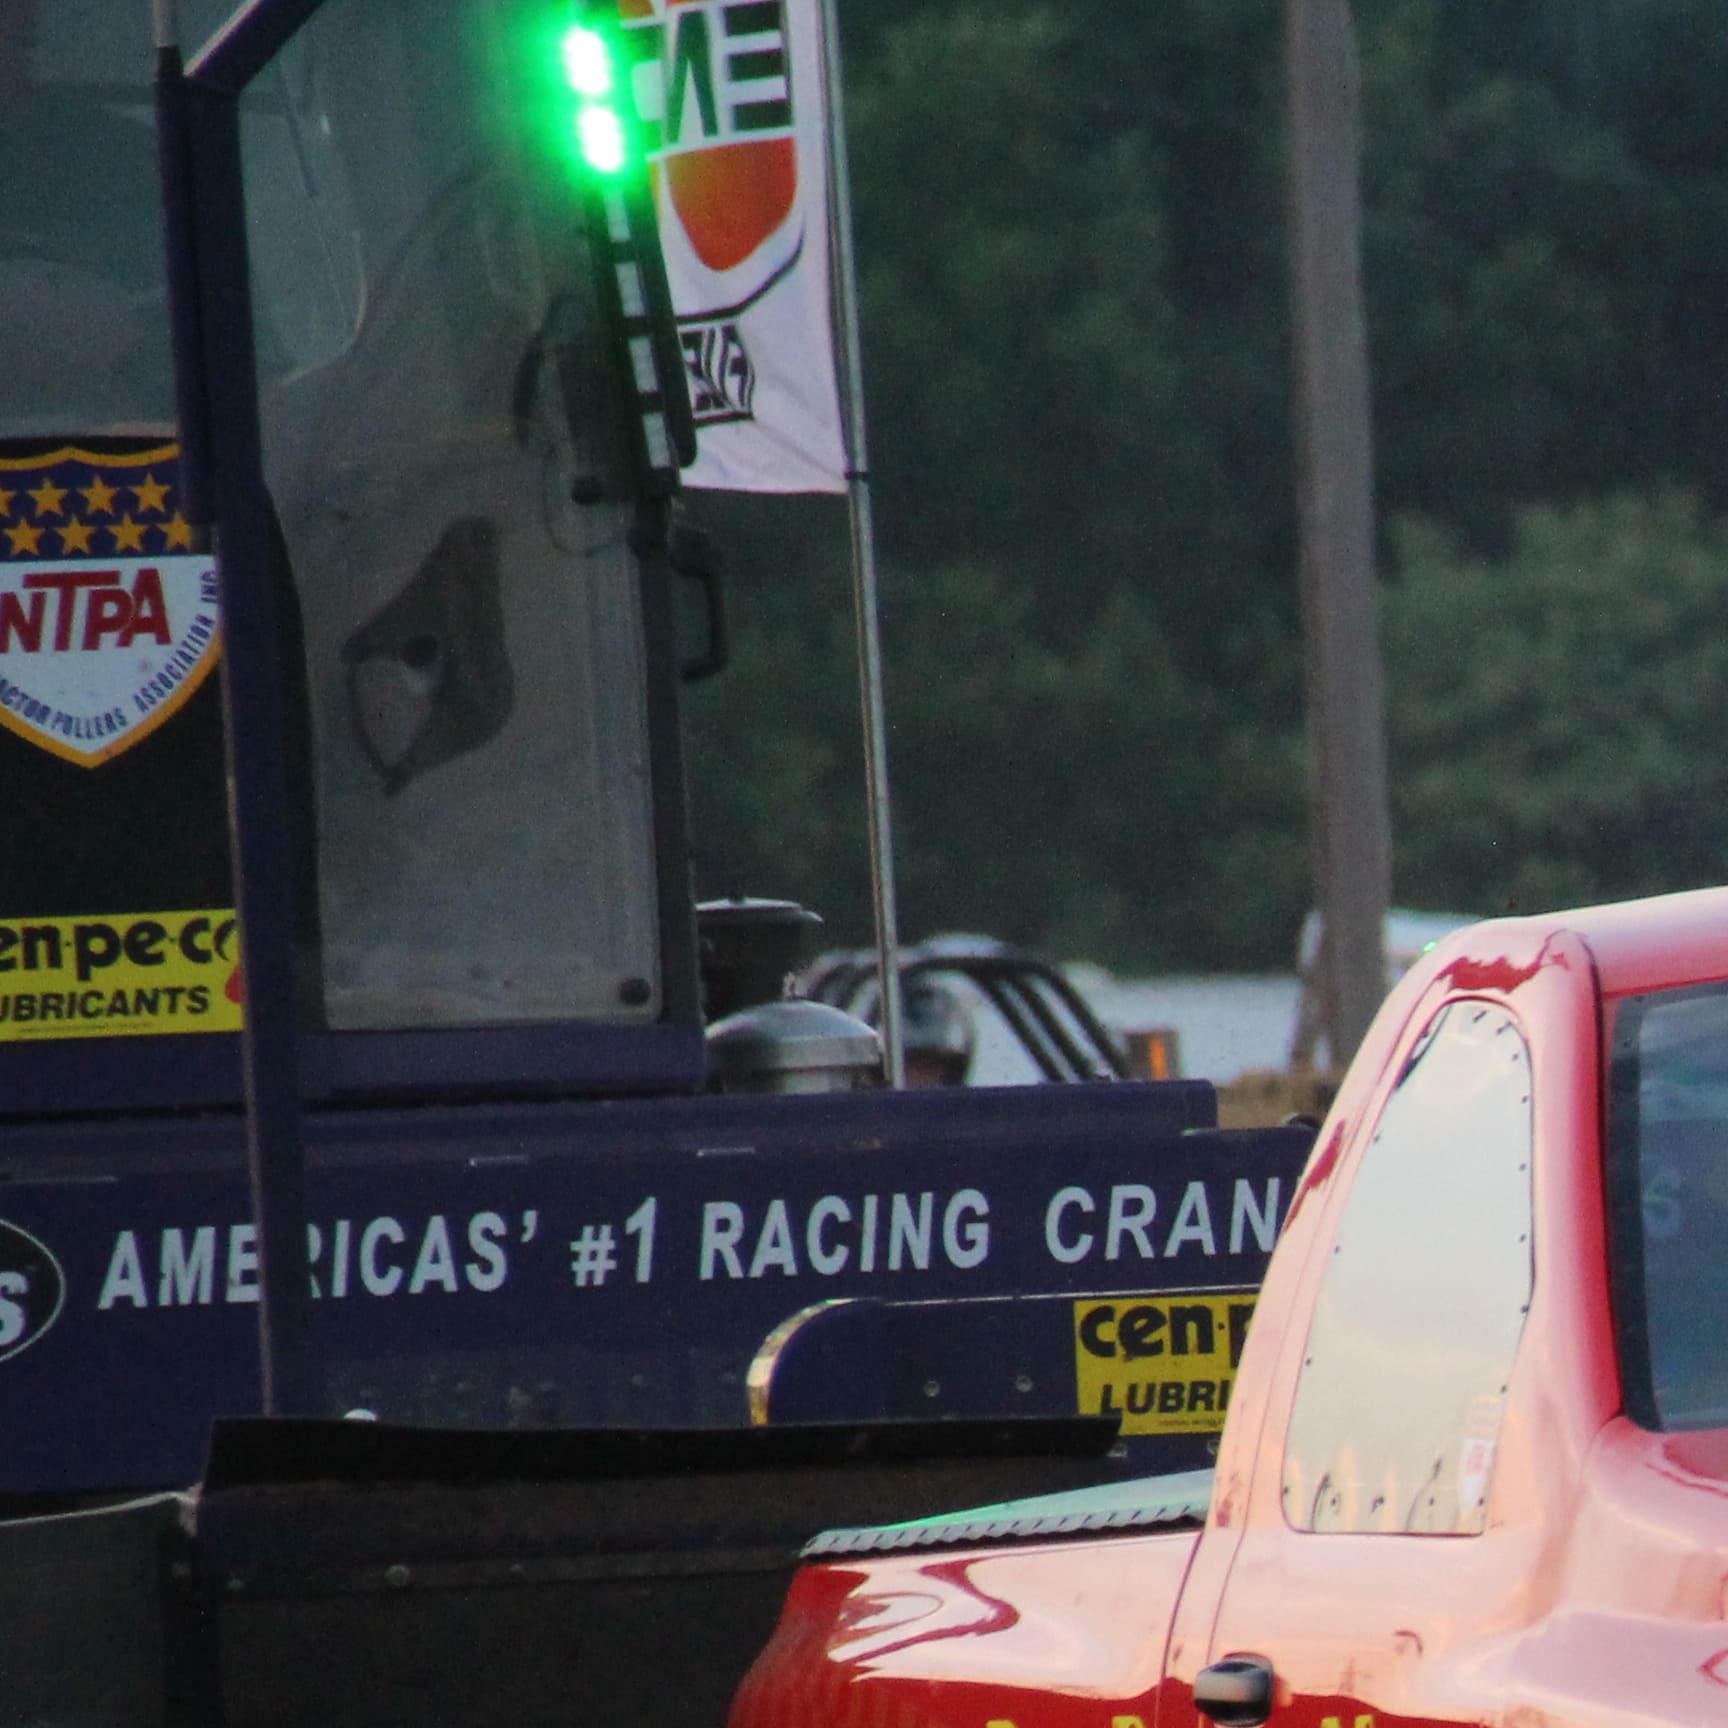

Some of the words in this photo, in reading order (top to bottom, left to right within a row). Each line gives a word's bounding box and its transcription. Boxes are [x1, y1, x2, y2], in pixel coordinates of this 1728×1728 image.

[0, 568, 172, 653] NTPA
[51, 706, 129, 739] PULLERS
[132, 613, 216, 714] ASSOCIATION
[570, 1197, 657, 1287] #1
[700, 1188, 990, 1281] RACING
